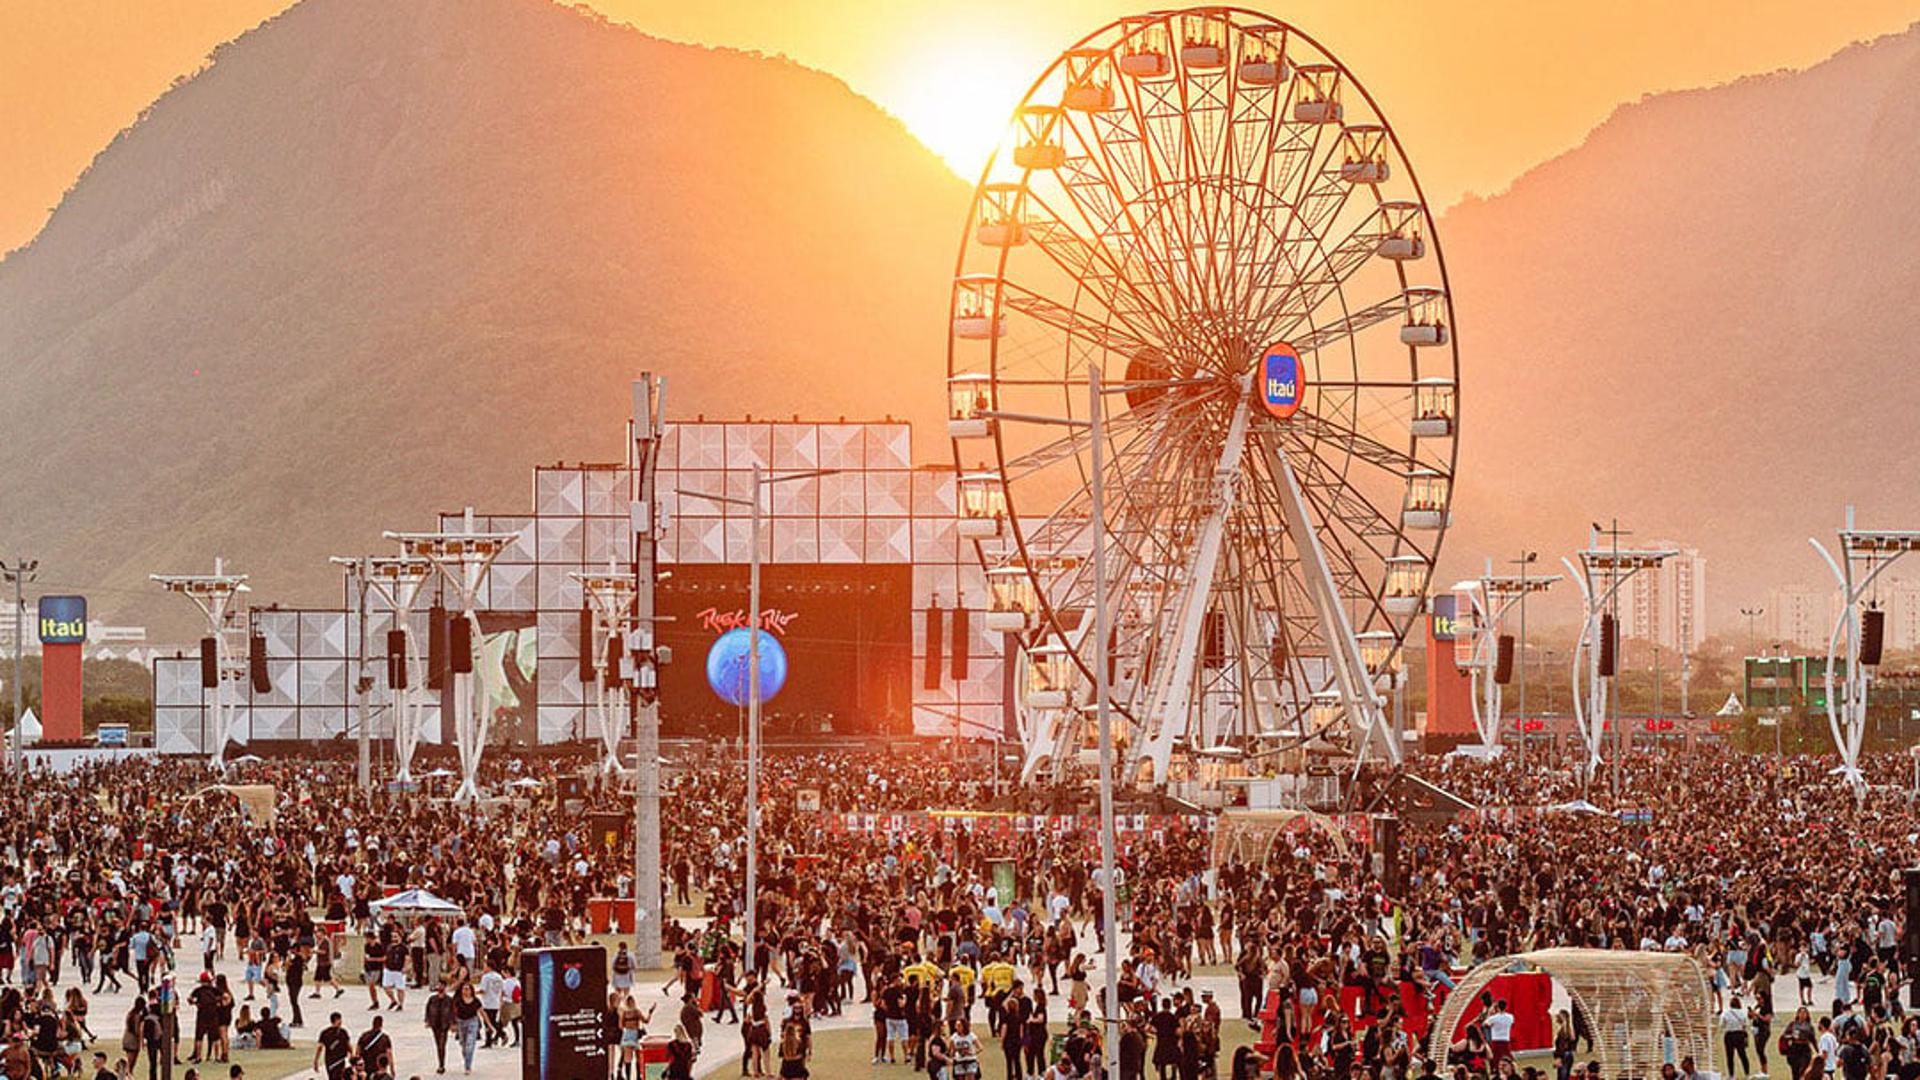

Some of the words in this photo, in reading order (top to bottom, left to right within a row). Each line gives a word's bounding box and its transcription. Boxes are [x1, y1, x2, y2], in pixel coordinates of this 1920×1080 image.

[1268, 378, 1296, 398] Itaú
[41, 618, 84, 637] Itaú
[760, 608, 799, 635] Rio
[1435, 616, 1456, 635] Ita
